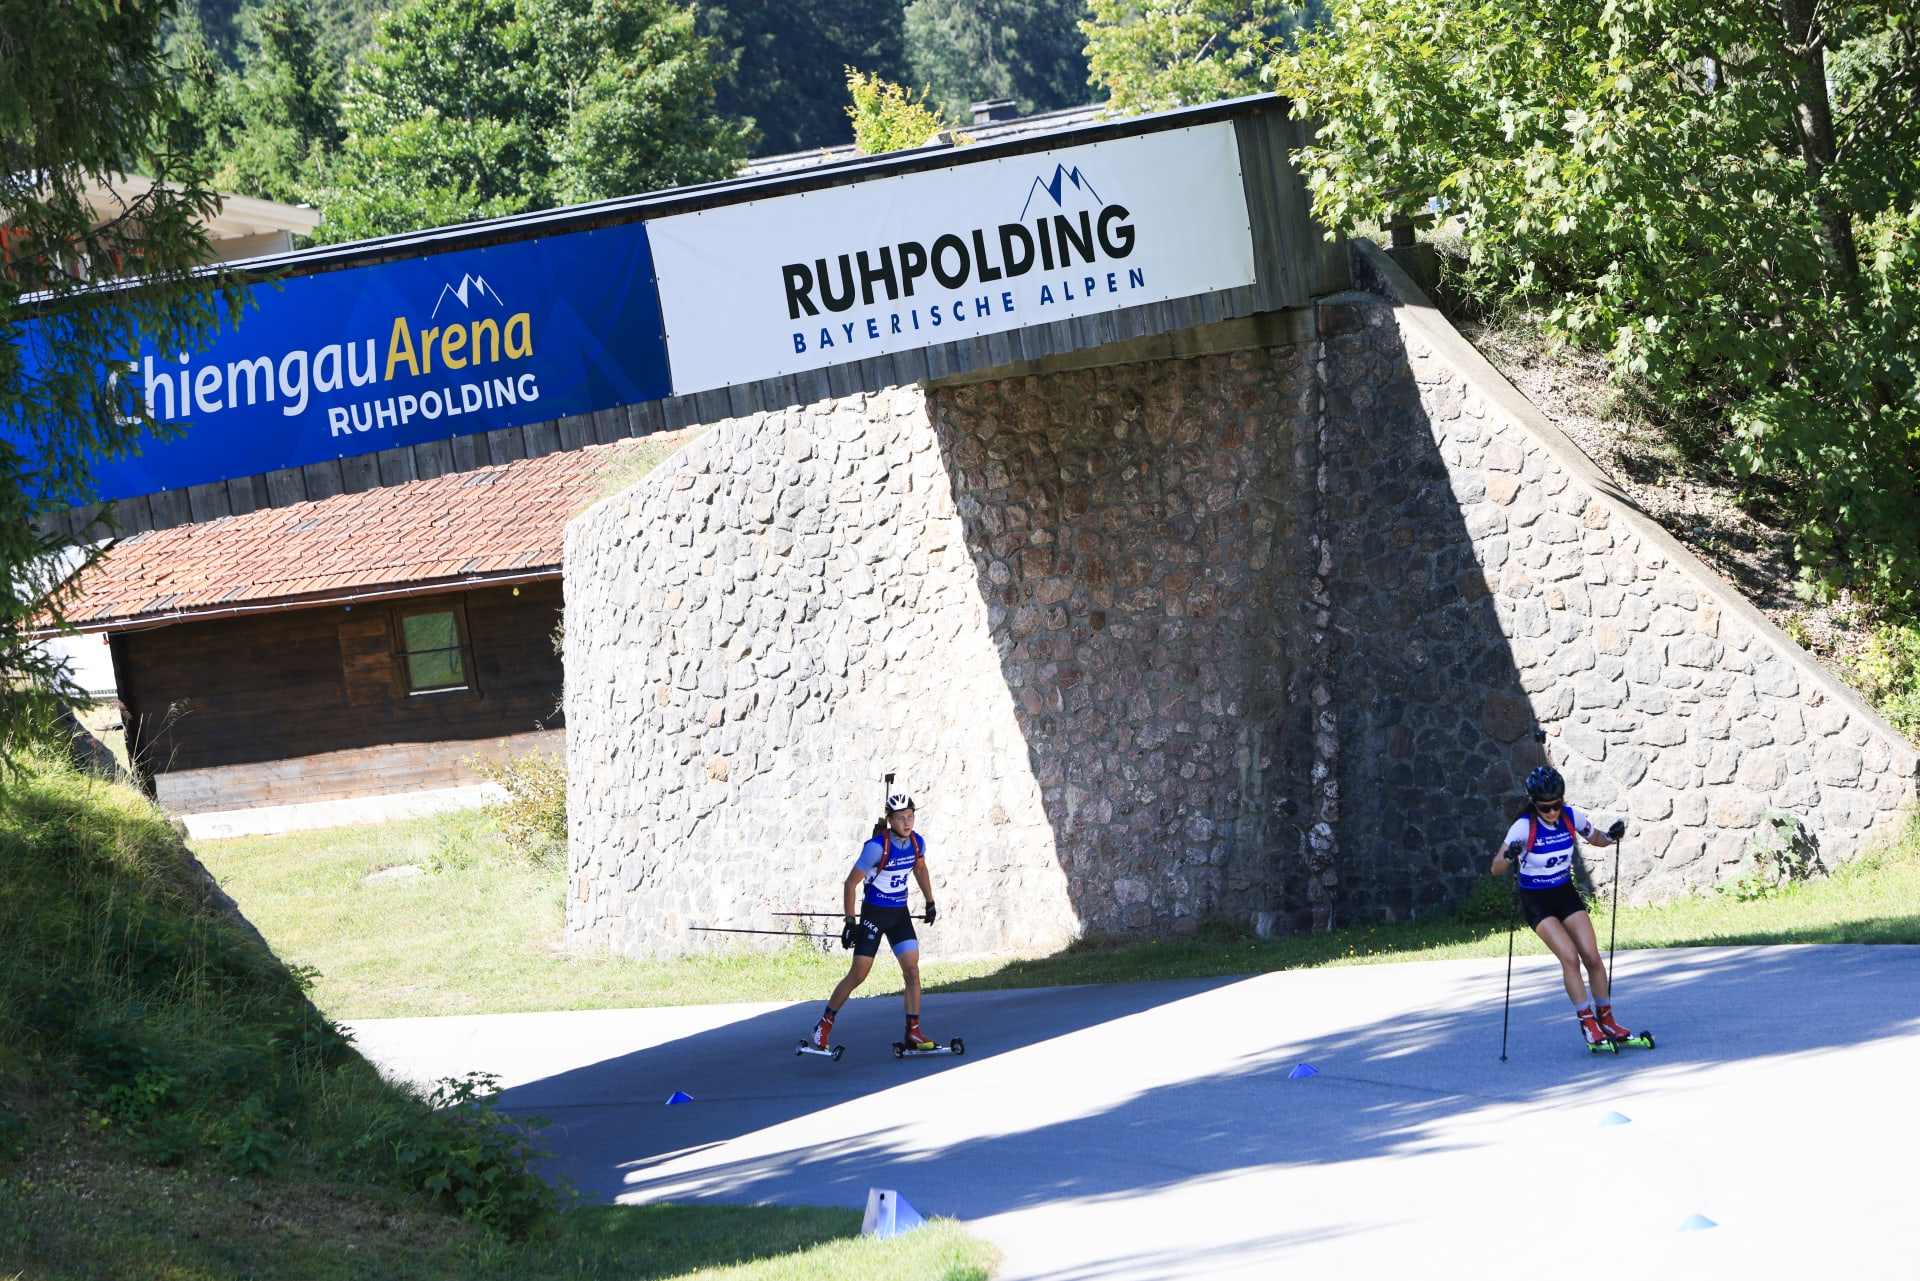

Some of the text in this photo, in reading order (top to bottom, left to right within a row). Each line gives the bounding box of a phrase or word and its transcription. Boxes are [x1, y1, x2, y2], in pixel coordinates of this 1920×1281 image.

[781, 204, 1136, 320] RUHPOLDING
[792, 267, 1146, 354] BAYERISCHE ALPEN
[105, 312, 533, 427] Chiemgau Arena
[327, 373, 540, 437] RUHPOLDING
[890, 873, 908, 889] 54
